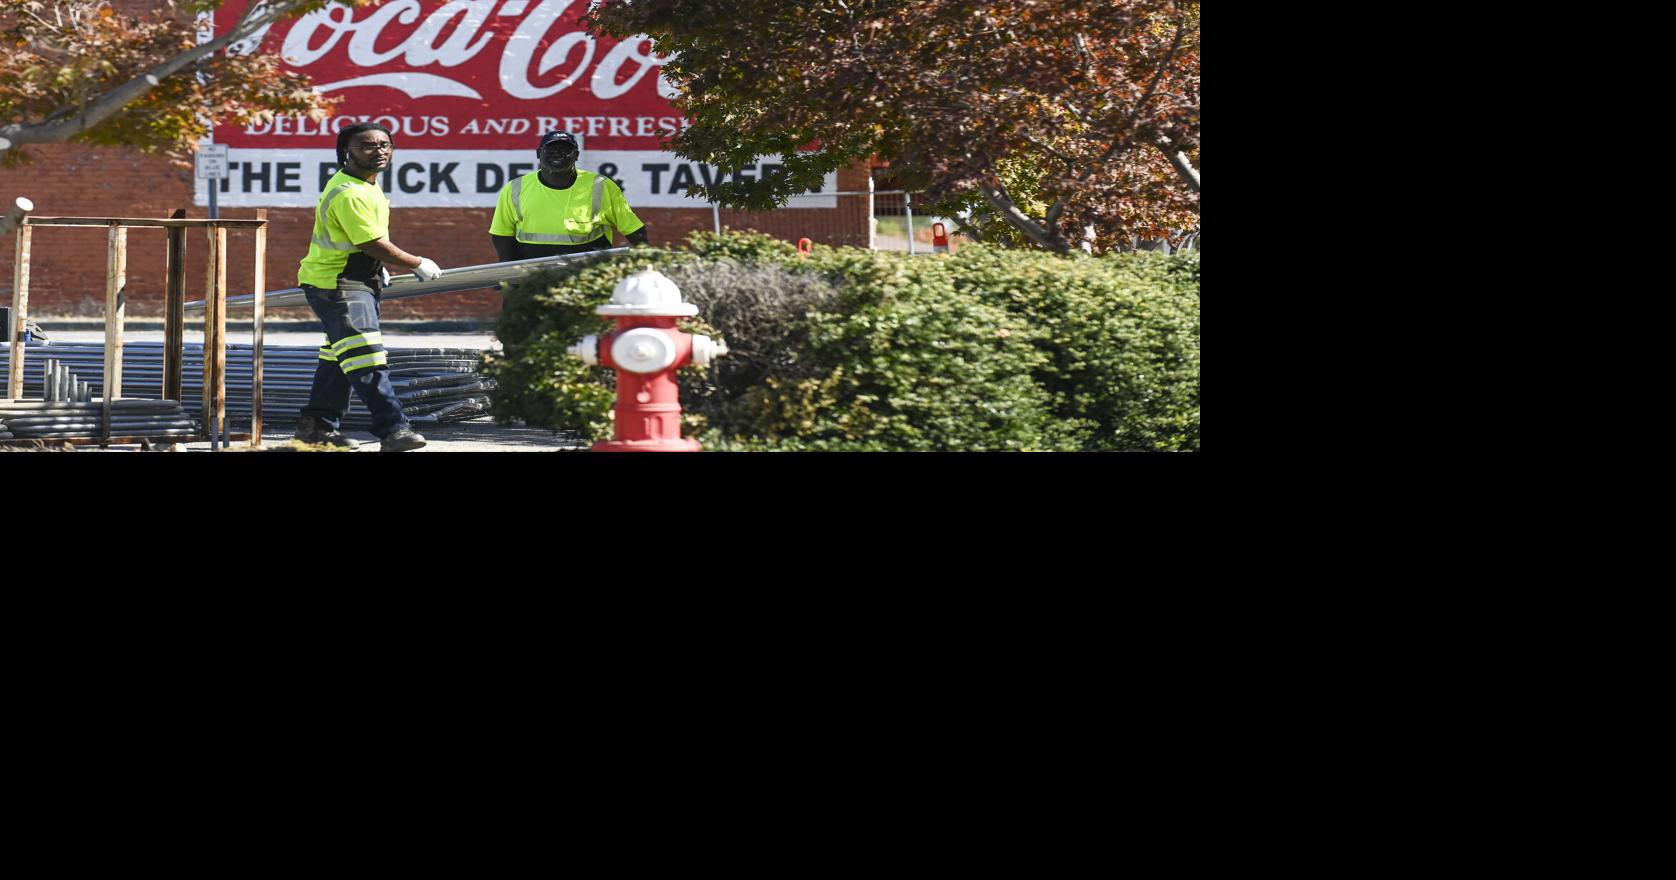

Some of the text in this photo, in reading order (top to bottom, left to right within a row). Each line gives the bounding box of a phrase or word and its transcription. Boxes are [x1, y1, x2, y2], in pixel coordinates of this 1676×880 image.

[245, 115, 450, 137] DELICOUS
[460, 117, 530, 136] AND
[221, 162, 301, 193] THE
[319, 162, 460, 193] BICK
